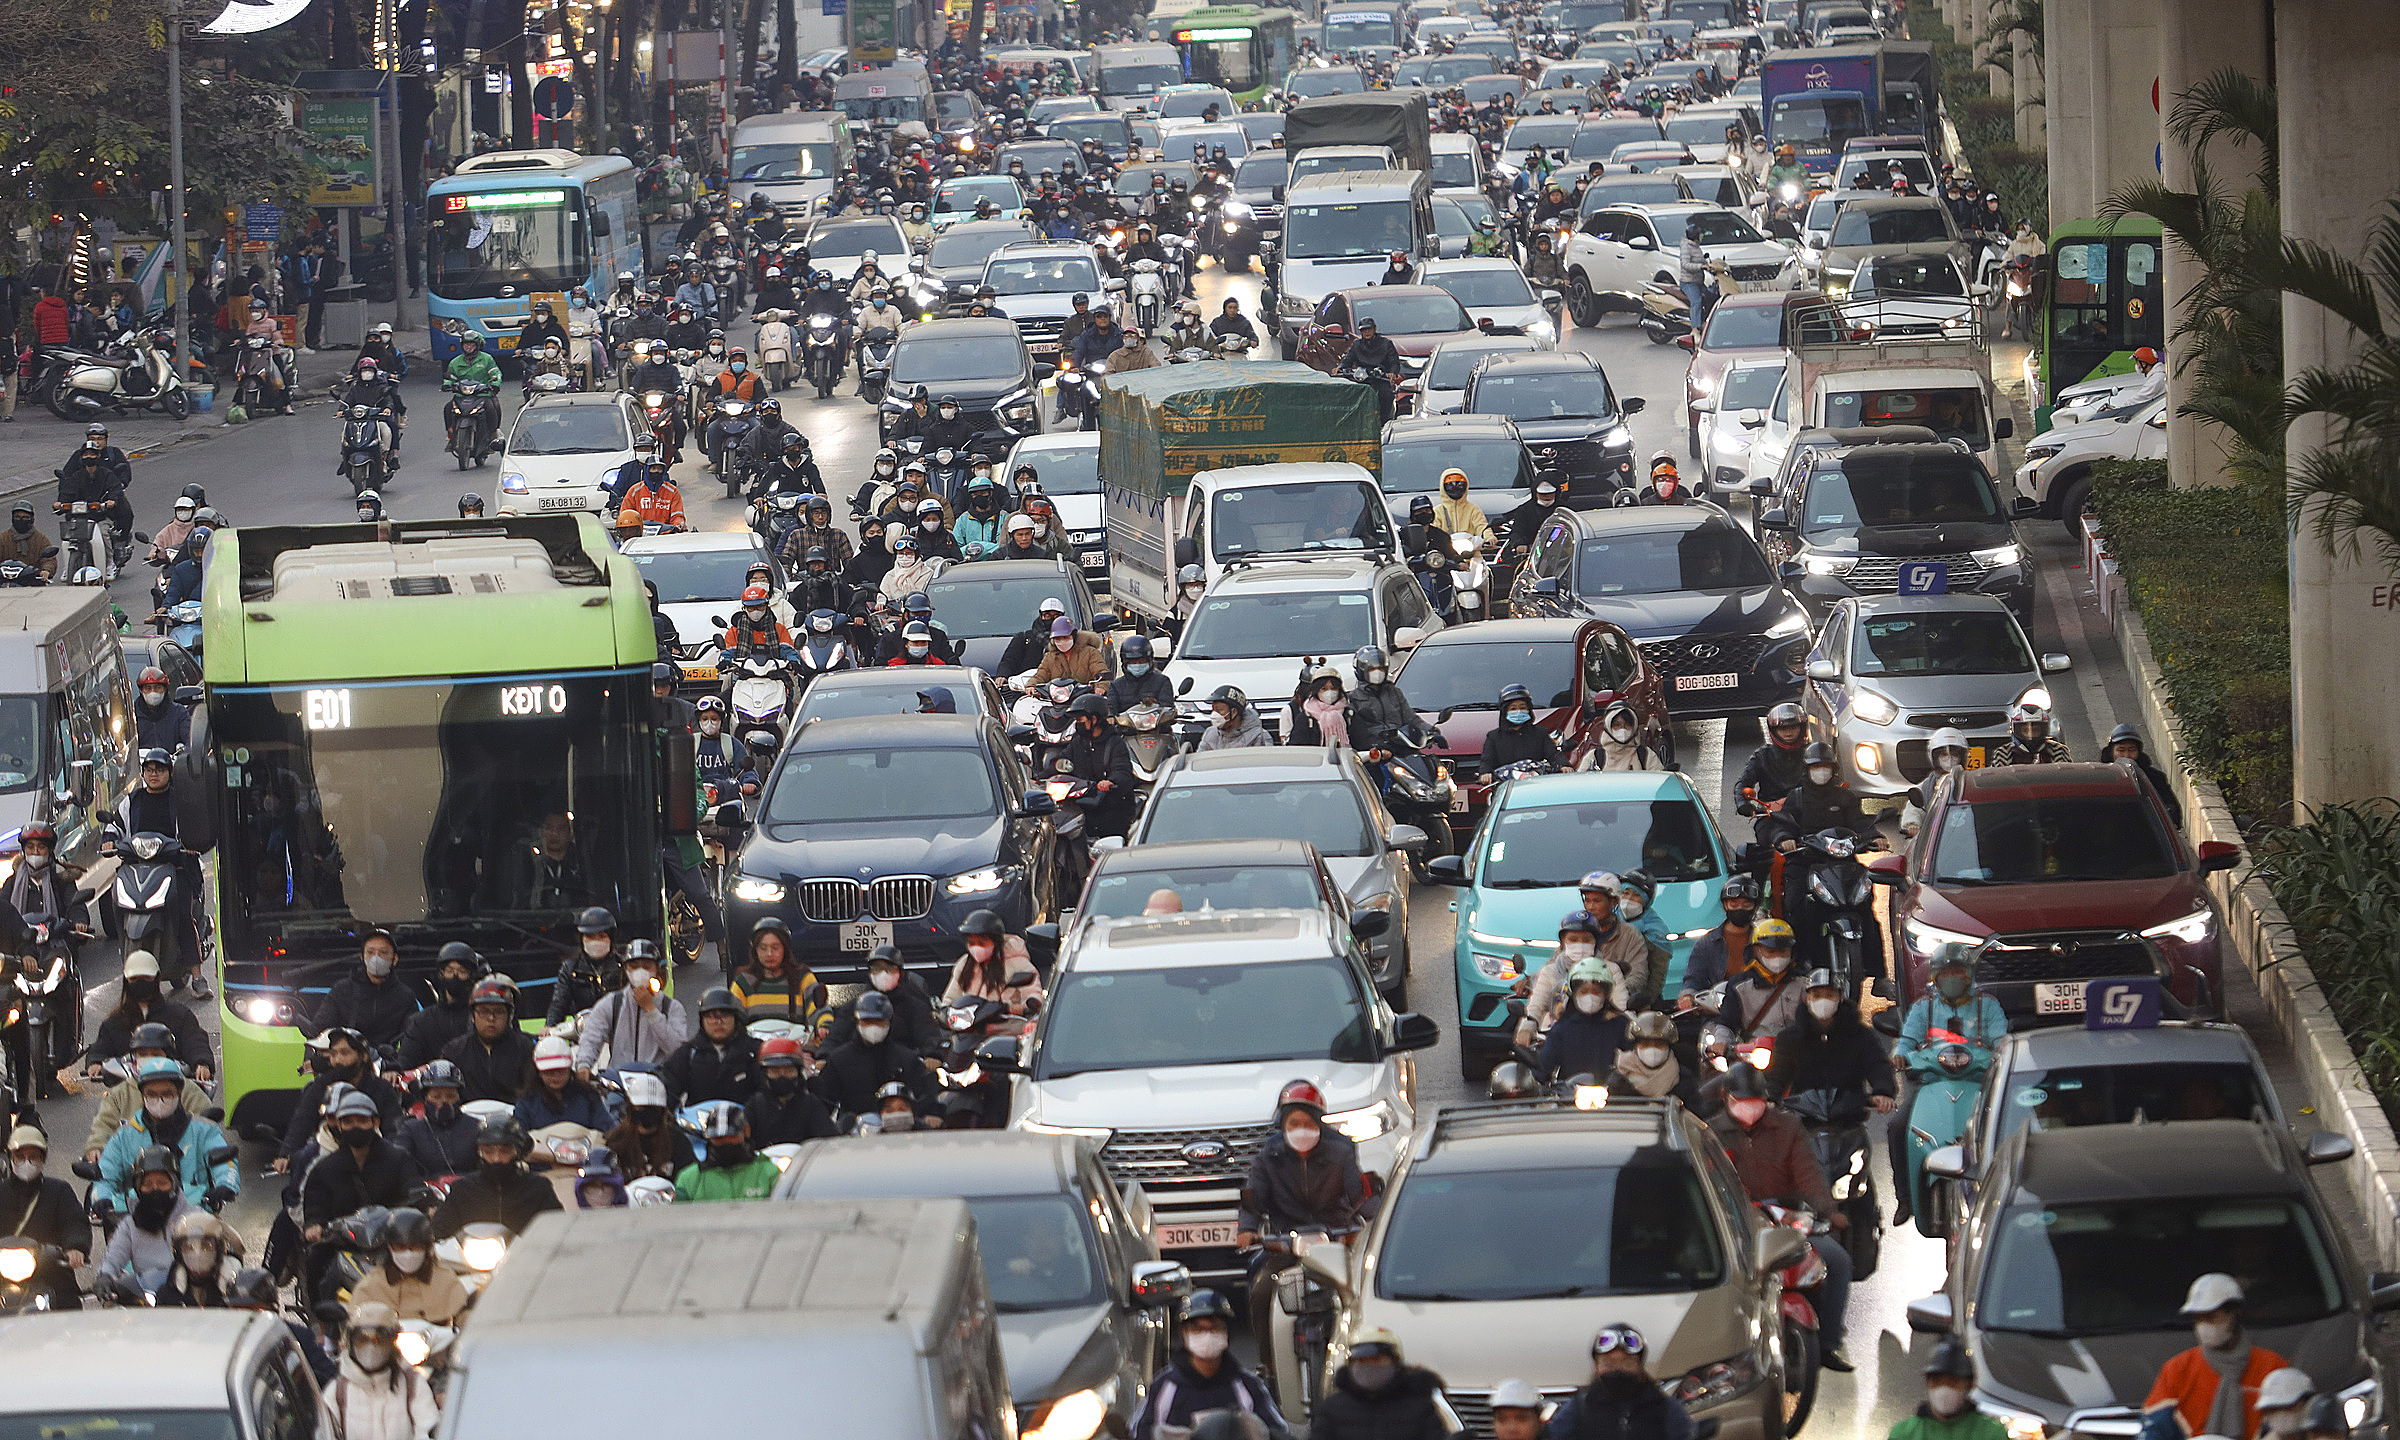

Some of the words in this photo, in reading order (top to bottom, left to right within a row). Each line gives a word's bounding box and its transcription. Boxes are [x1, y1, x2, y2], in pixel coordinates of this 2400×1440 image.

[1081, 556, 1104, 566] 98.35
[1911, 567, 1936, 591] G7
[1679, 675, 1736, 689] 30G-086.81
[307, 689, 350, 729] E01
[502, 686, 543, 715] KĐT
[855, 926, 877, 936] 30K
[2054, 985, 2079, 997] 30H
[2044, 998, 2086, 1011] 988.6
[2104, 985, 2143, 1023] G7
[1167, 1228, 1236, 1244] 30K-067.
